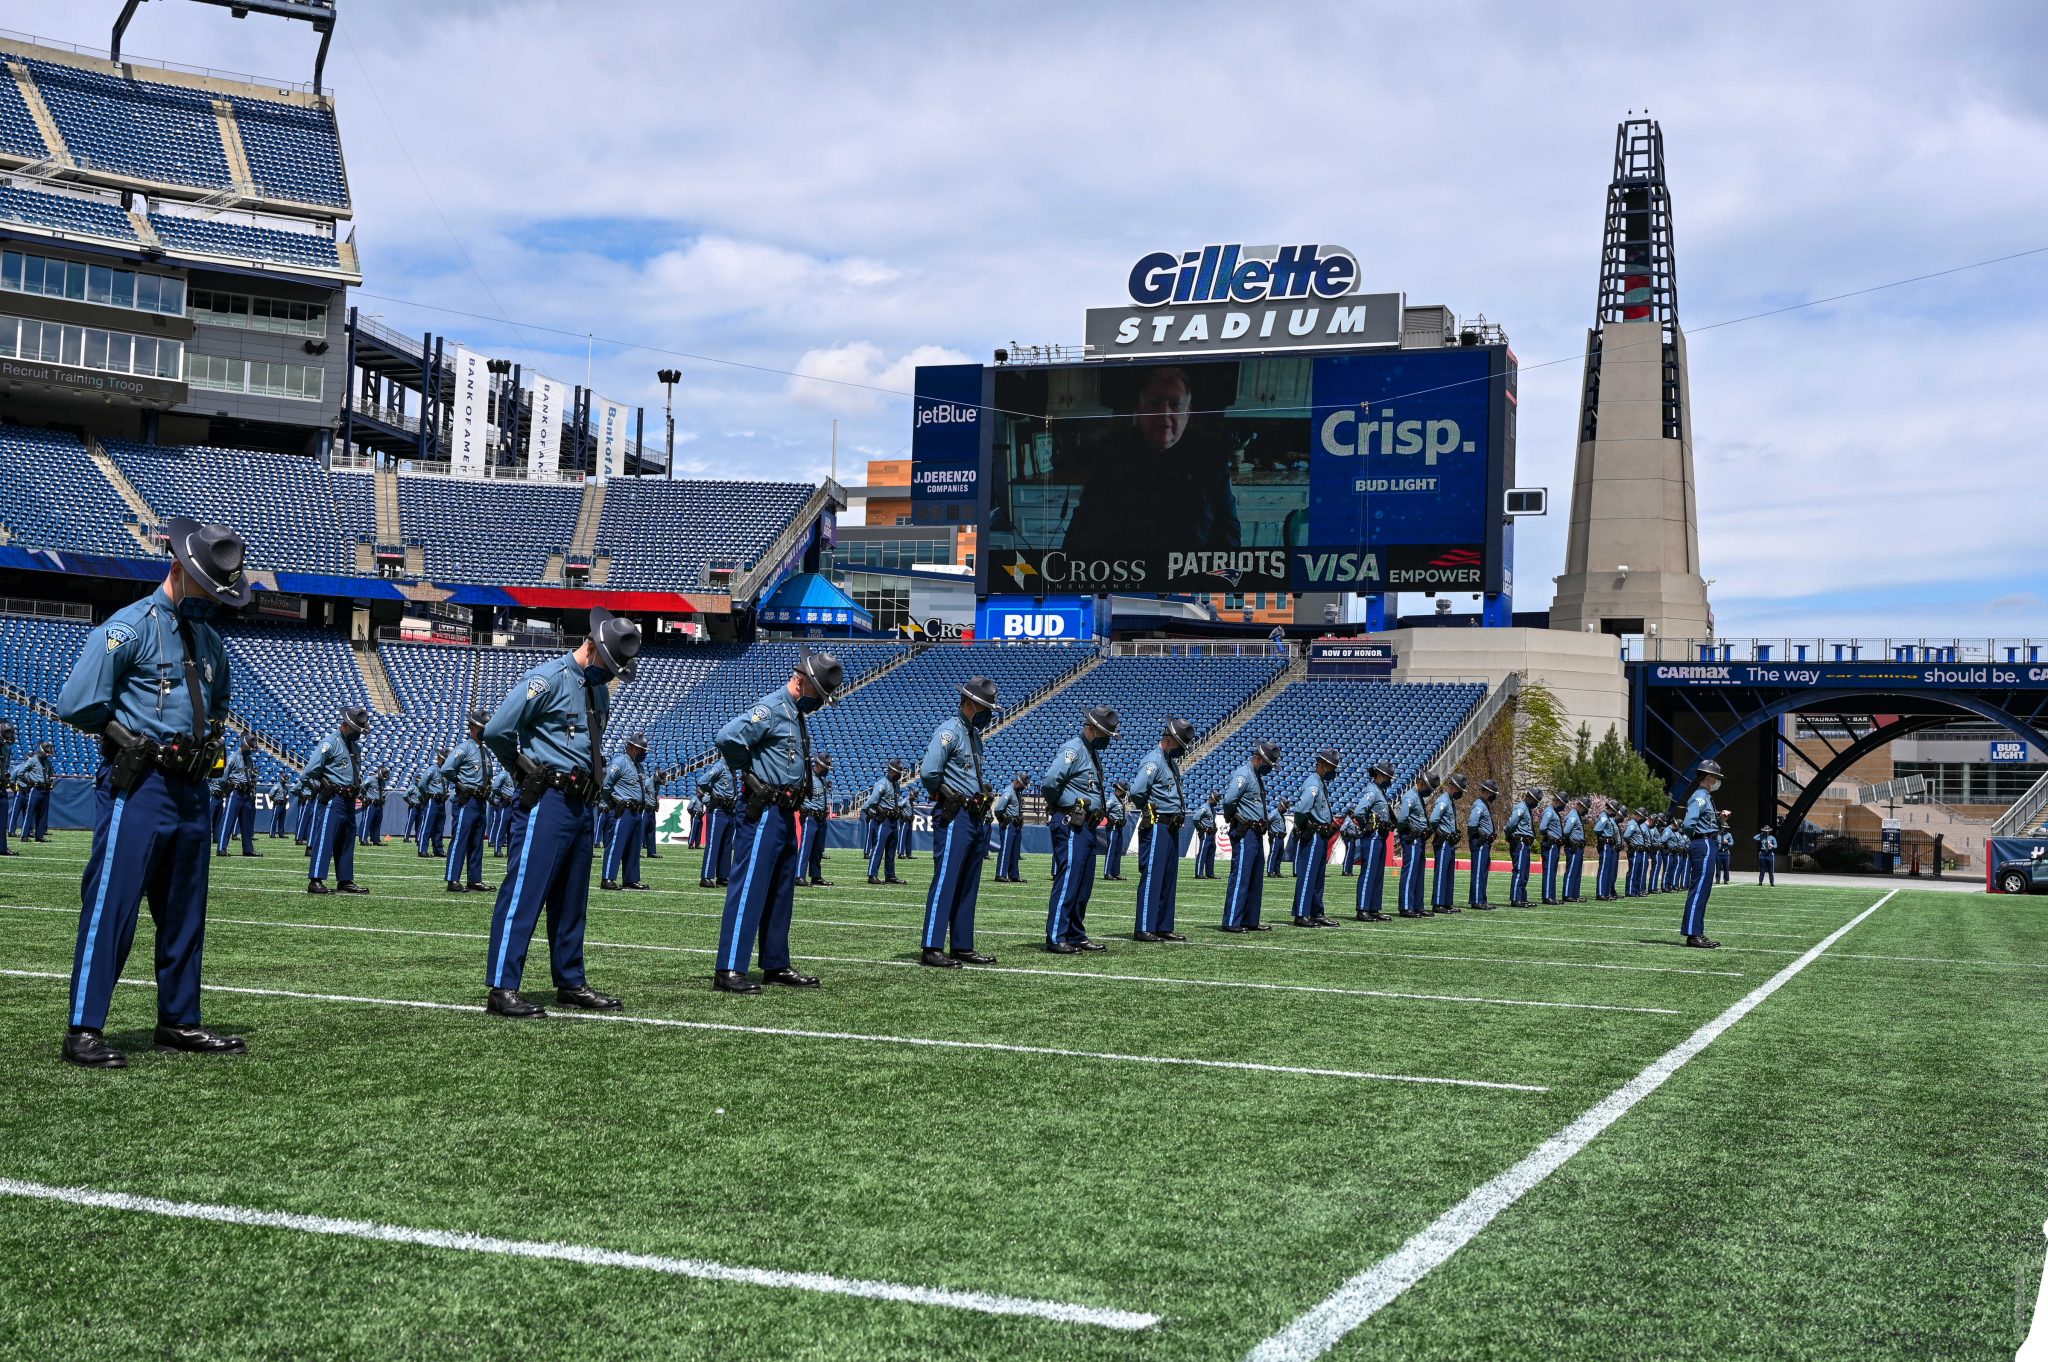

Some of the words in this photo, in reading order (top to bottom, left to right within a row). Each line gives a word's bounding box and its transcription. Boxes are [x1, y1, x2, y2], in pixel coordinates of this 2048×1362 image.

[1127, 243, 1358, 307] Gillette
[1115, 306, 1366, 344] STADIUM
[2, 362, 49, 379] Recruit
[52, 369, 103, 388] Training
[107, 376, 144, 393] Troop
[465, 357, 476, 401] BANK
[541, 383, 551, 425] BANK
[465, 405, 472, 429] OF
[605, 406, 617, 445] Bank
[916, 405, 978, 428] jetBlue
[540, 429, 547, 448] OF
[1321, 408, 1475, 466] Crisp.
[604, 447, 613, 464] of
[914, 470, 976, 484] J.DERENZO
[927, 484, 969, 493] COMPANIES
[1355, 479, 1388, 492] BUD
[1390, 478, 1437, 491] LIGHT
[1168, 551, 1286, 580] PATRIOTS
[1297, 553, 1380, 582] VISA
[1389, 569, 1481, 584] EMPOWER
[923, 618, 976, 638] CRO
[1004, 614, 1065, 637] BUD
[1747, 667, 1780, 681] The
[1784, 670, 1820, 685] way
[1924, 668, 1987, 683] should
[1993, 667, 2020, 683] be.
[1992, 751, 2025, 760] LIGHT
[1996, 743, 2021, 751] BUD
